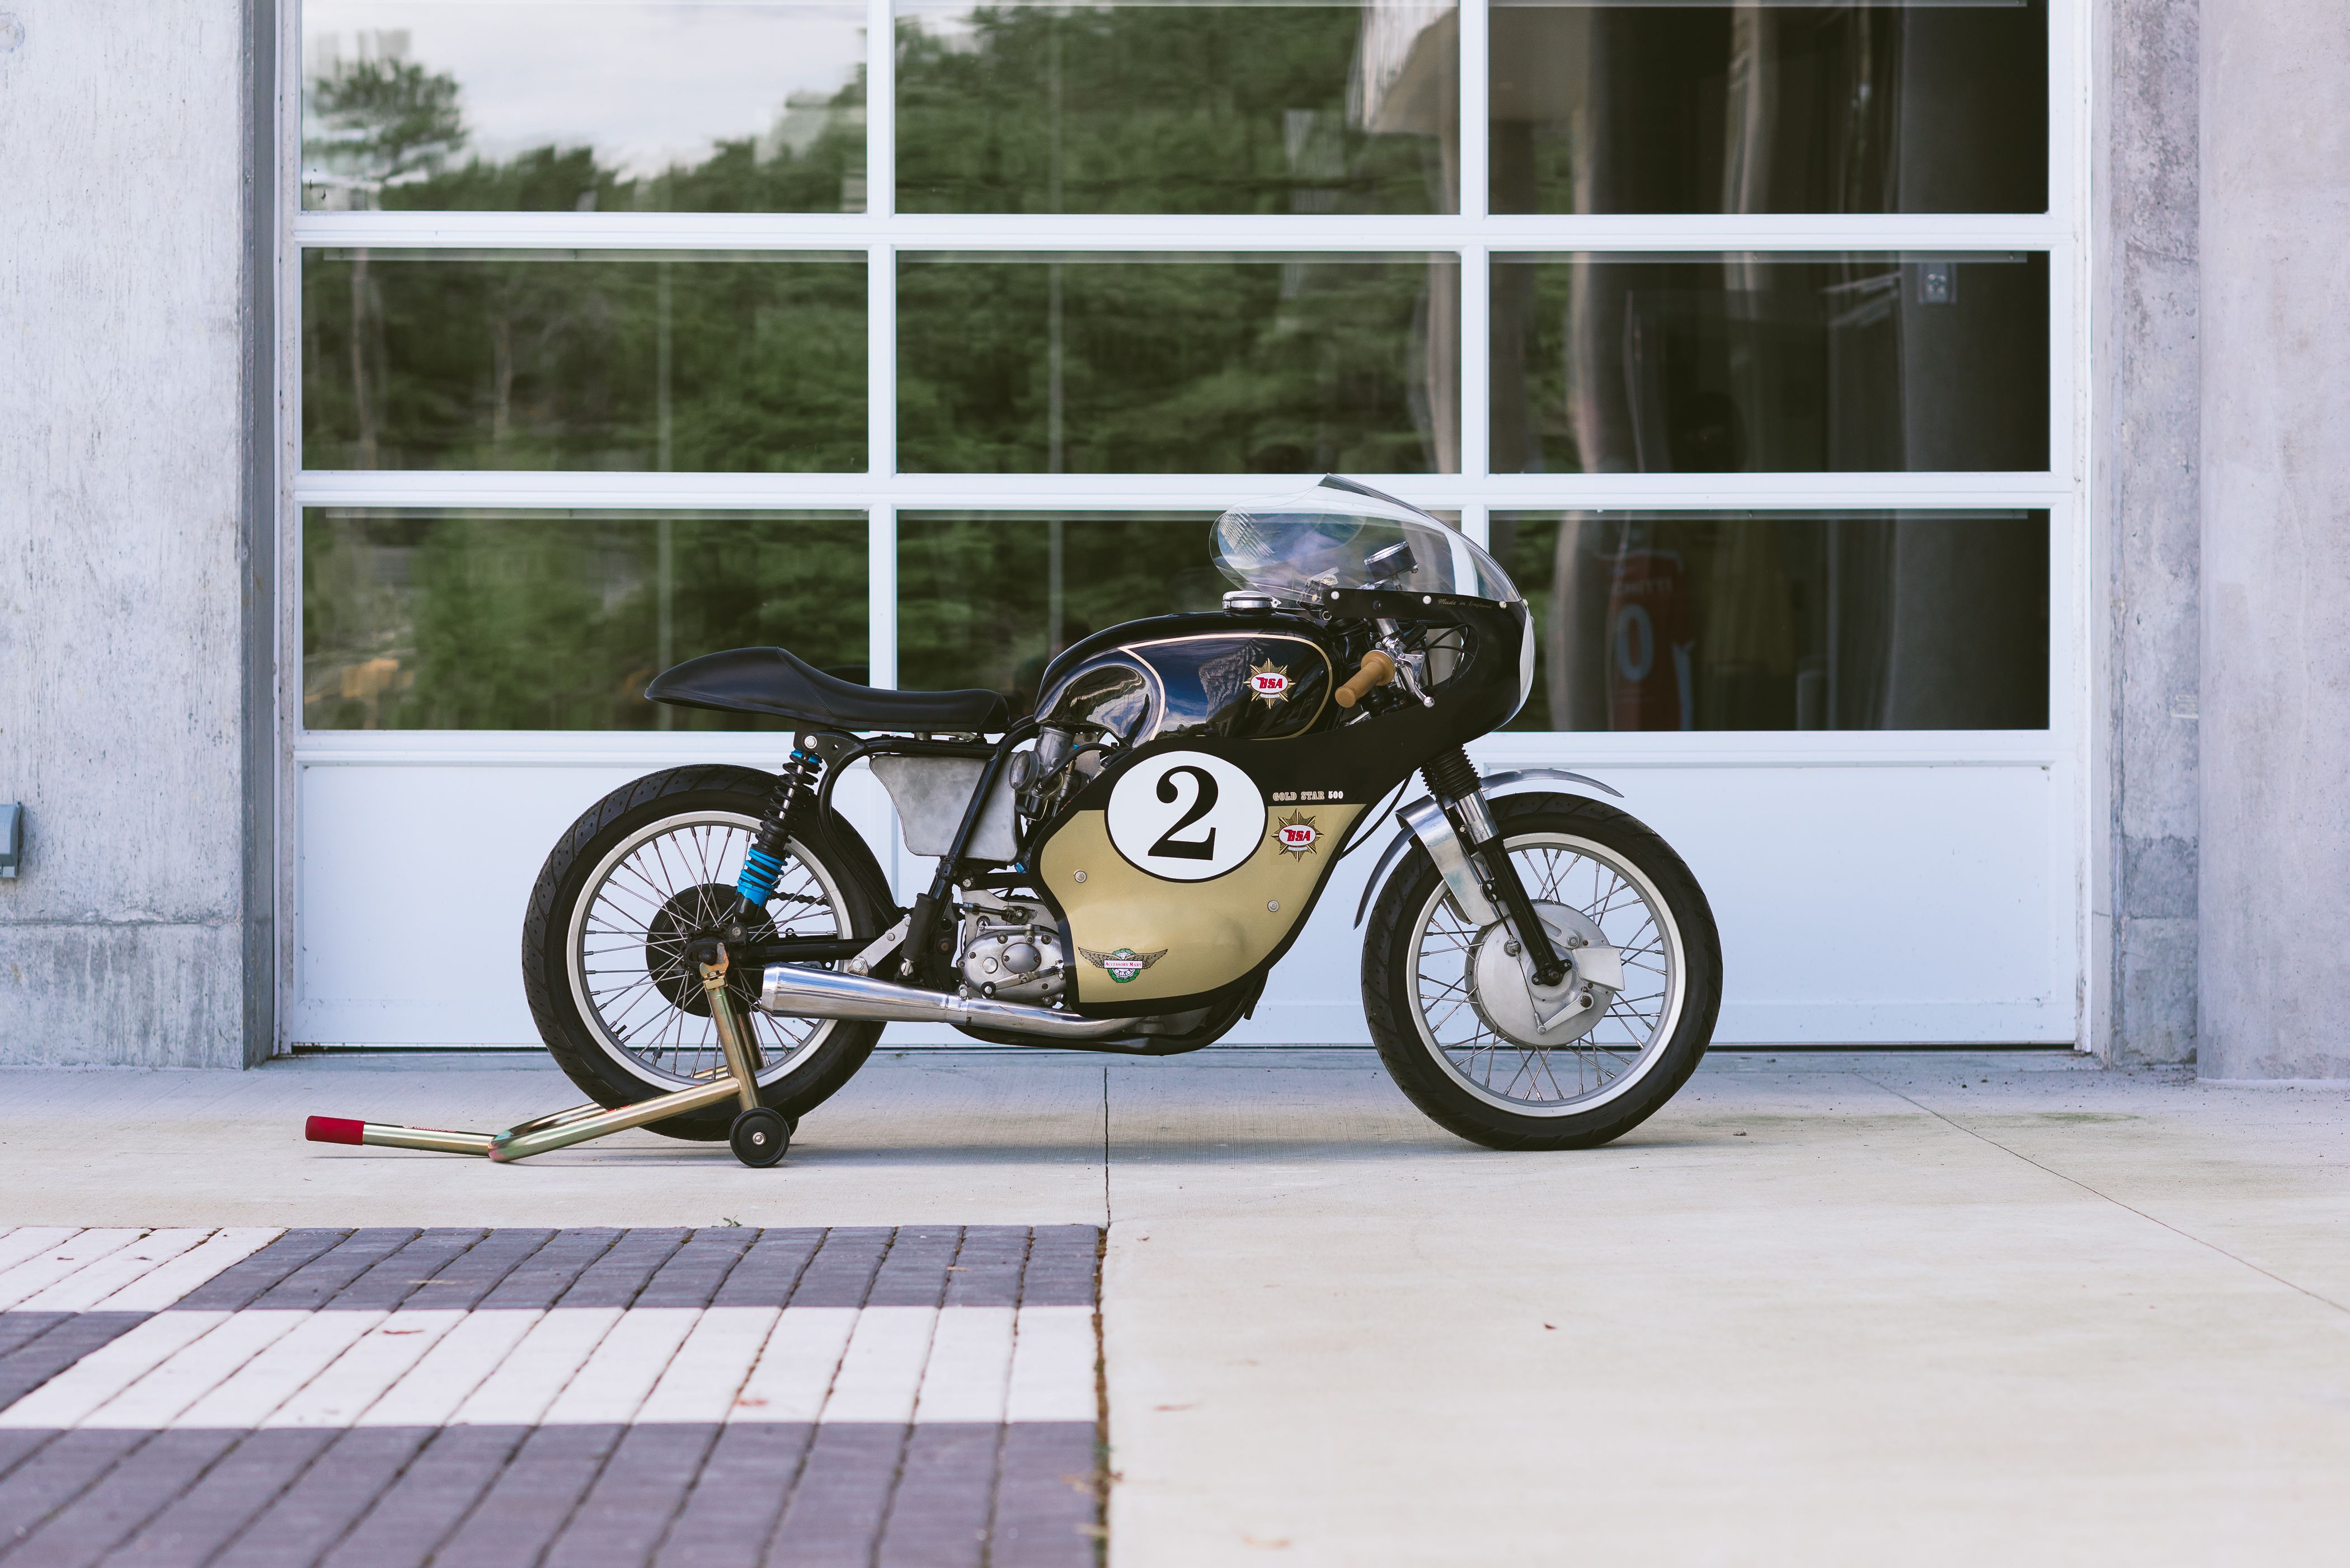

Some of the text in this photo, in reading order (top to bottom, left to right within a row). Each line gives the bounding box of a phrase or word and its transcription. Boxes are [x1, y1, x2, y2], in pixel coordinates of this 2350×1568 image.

[1255, 677, 1283, 689] BSA
[1272, 790, 1343, 801] GOLD STAR 500
[1148, 765, 1219, 860] 2
[1283, 829, 1311, 842] BSA
